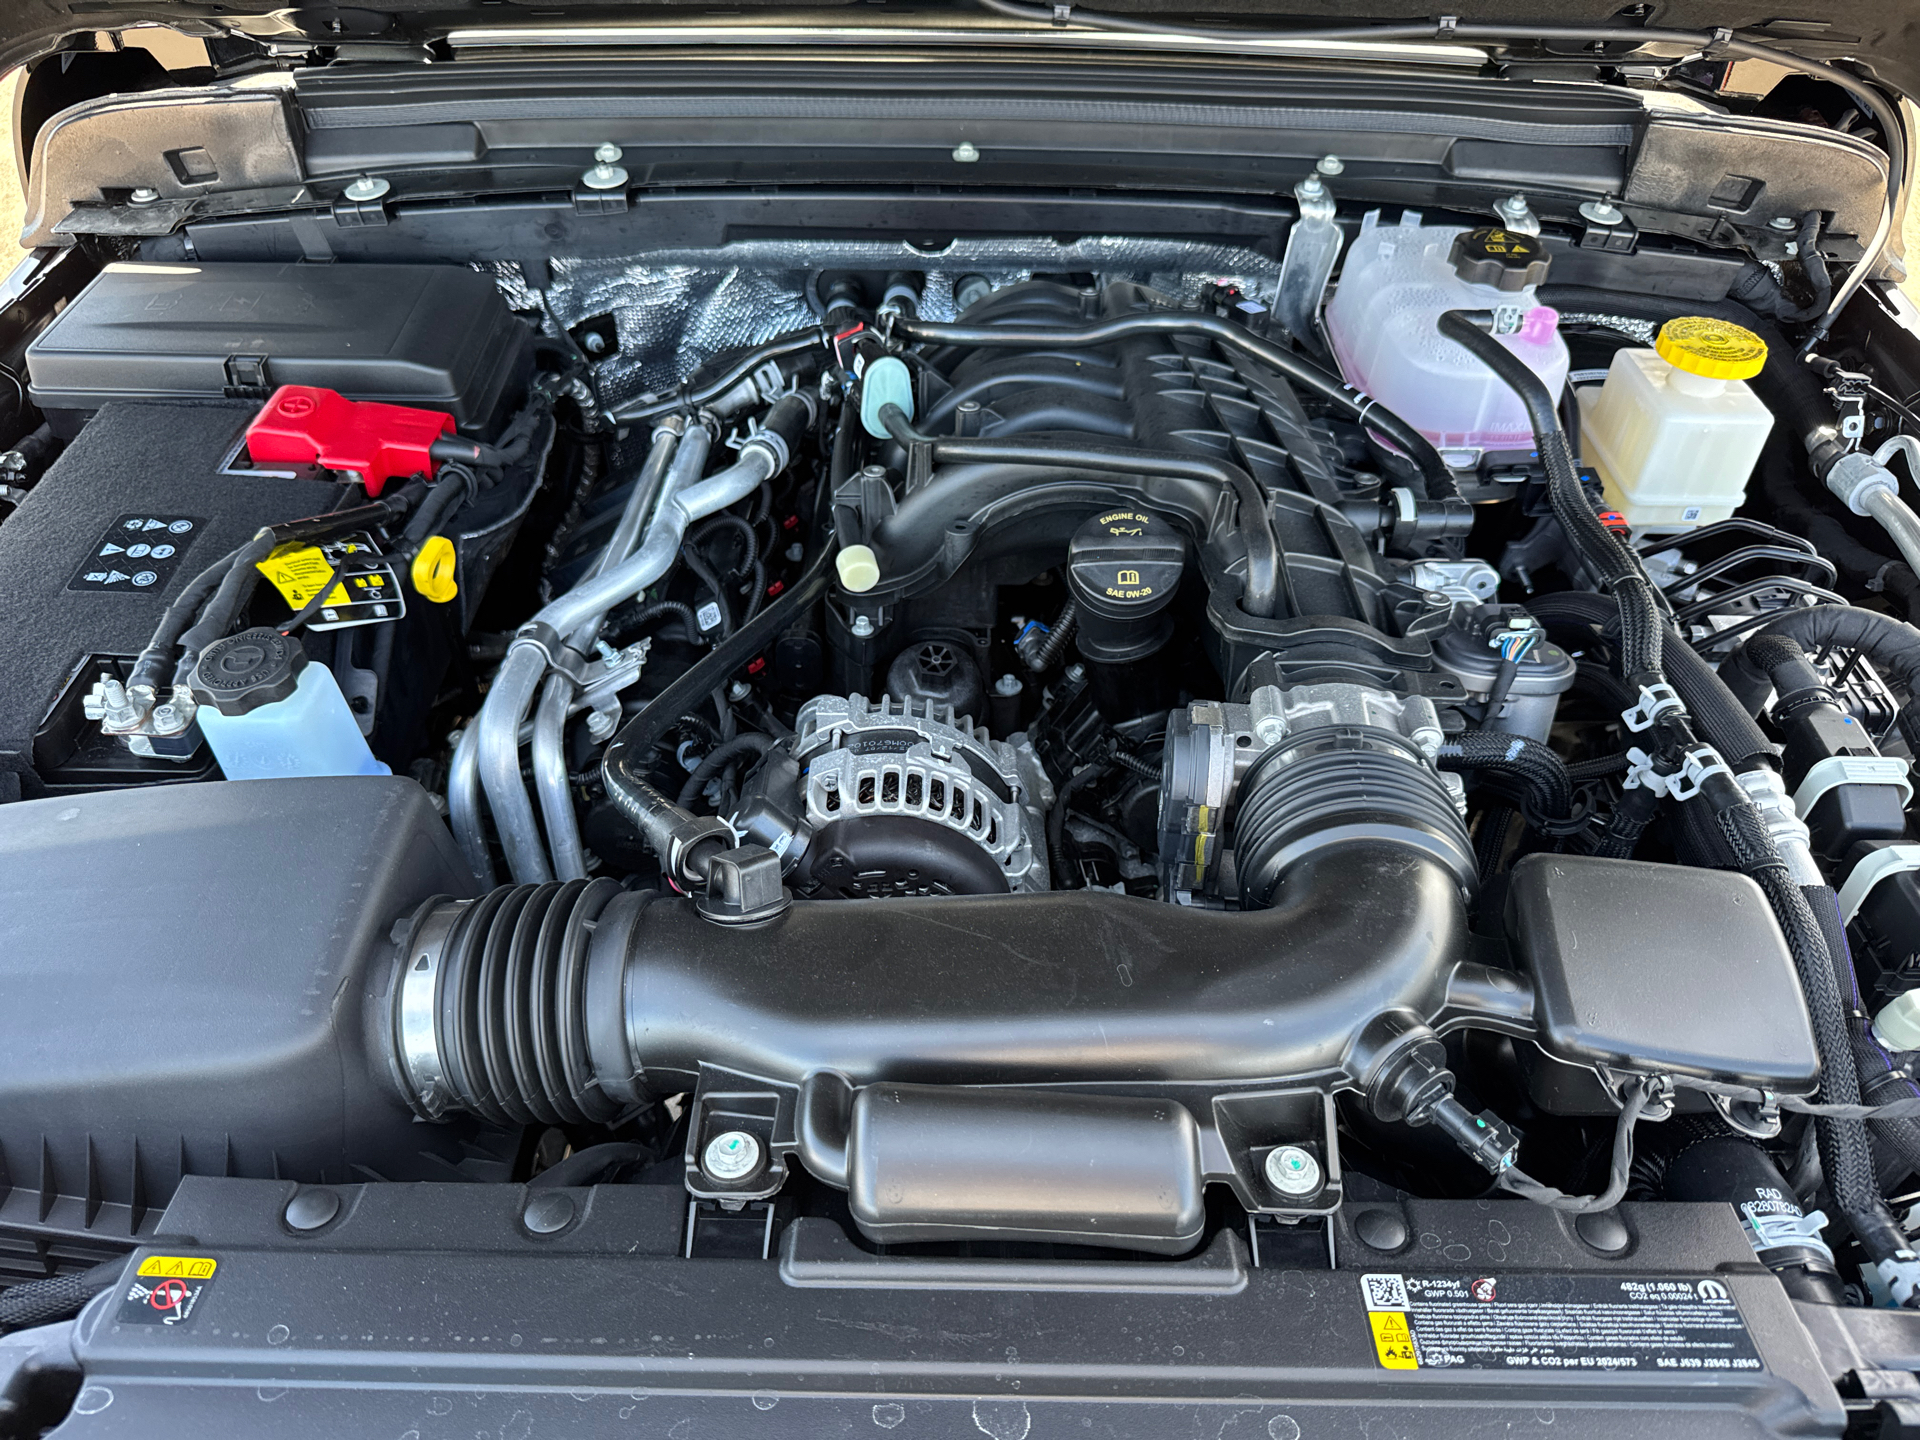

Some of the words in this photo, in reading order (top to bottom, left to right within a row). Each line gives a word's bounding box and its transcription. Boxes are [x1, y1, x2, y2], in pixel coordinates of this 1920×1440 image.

[1099, 512, 1134, 525] ENGINE
[1136, 513, 1150, 524] OIL
[1105, 587, 1125, 598] SAE
[1126, 586, 1153, 598] 0W-20
[1755, 1188, 1782, 1200] RAD
[1424, 1290, 1446, 1298] GWP
[1447, 1290, 1469, 1298] 0.501
[1620, 1282, 1646, 1294] 482g
[1629, 1292, 1648, 1300] CO2
[1443, 1355, 1465, 1363] PAG
[1506, 1355, 1530, 1365] GWP
[1541, 1356, 1562, 1365] CO2
[1563, 1357, 1579, 1367] per
[1580, 1357, 1595, 1366] EU
[1656, 1358, 1678, 1367] SAE
